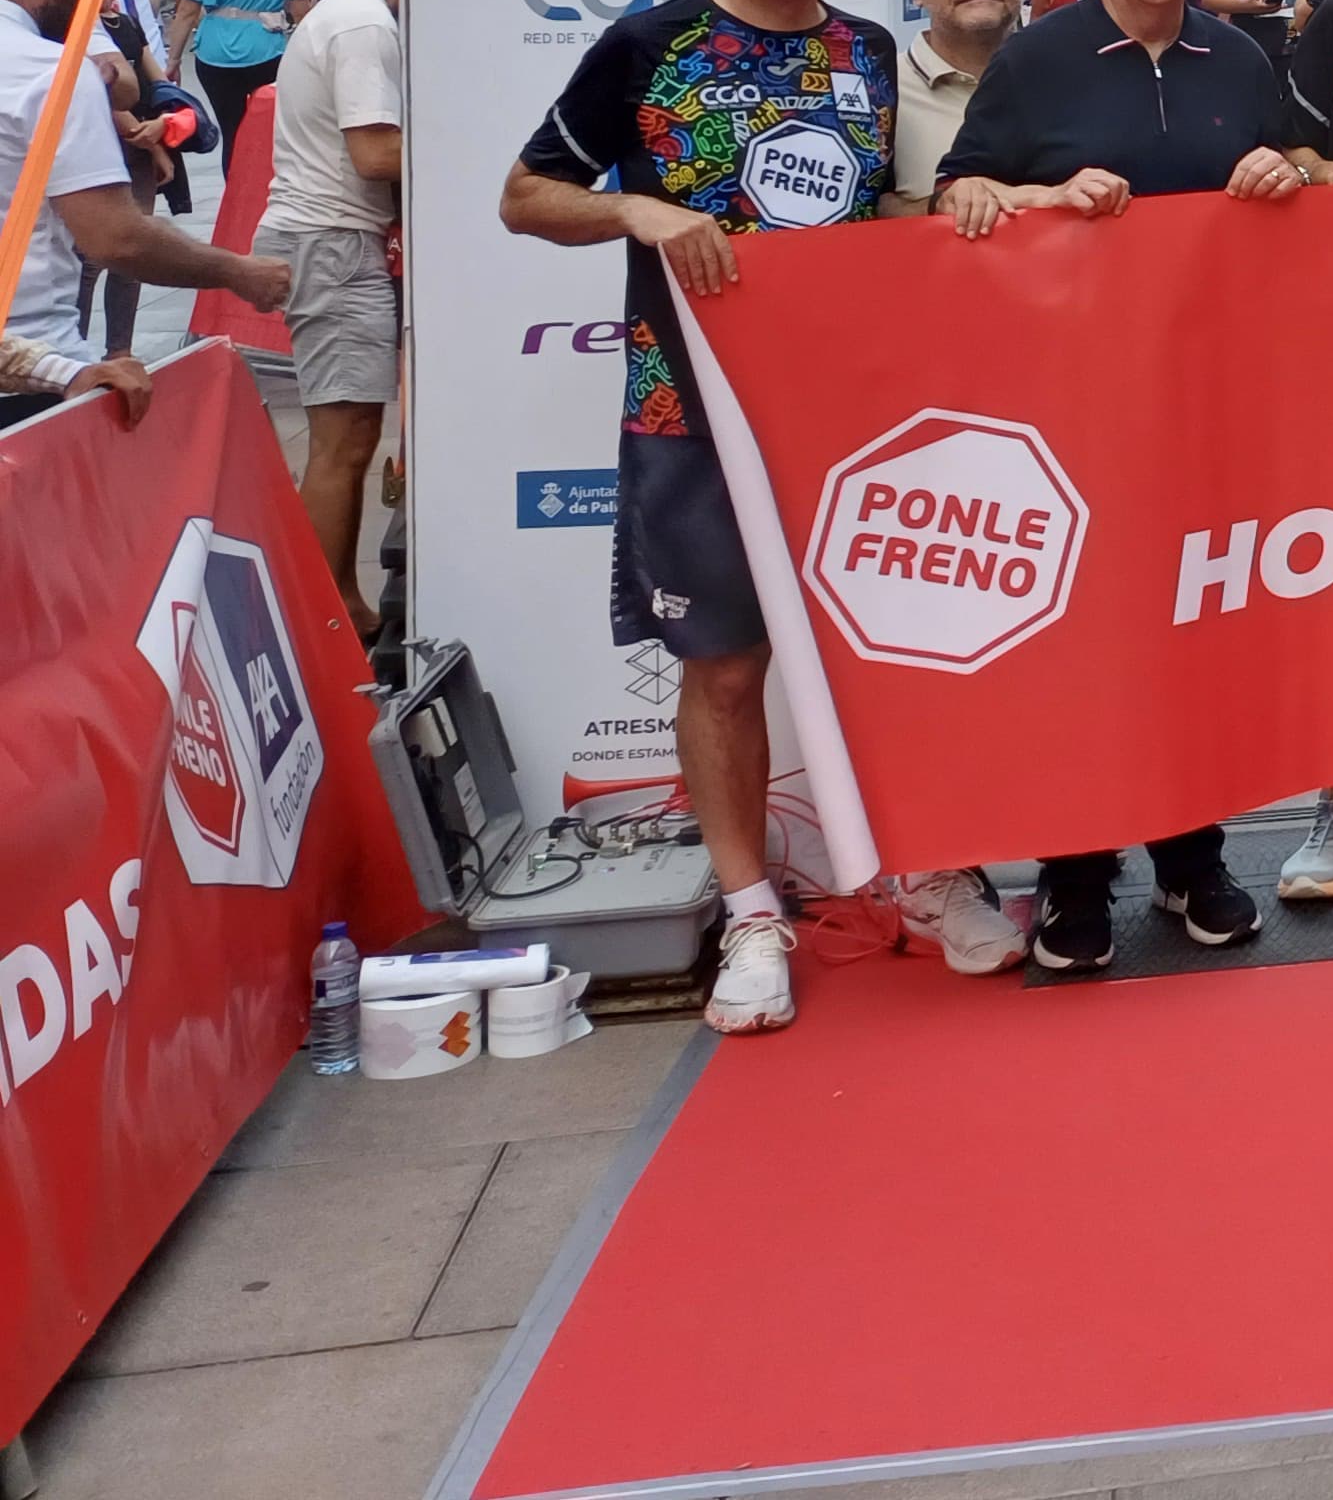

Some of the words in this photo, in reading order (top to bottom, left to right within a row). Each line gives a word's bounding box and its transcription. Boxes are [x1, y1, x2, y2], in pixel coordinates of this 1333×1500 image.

[523, 32, 552, 44] RED
[556, 32, 576, 44] DE
[764, 148, 846, 184] PONLE
[760, 168, 841, 203] FRENO
[569, 501, 588, 514] de
[856, 481, 1051, 552] PONLE
[843, 531, 1038, 598] FRENO
[572, 749, 624, 763] DONDE
